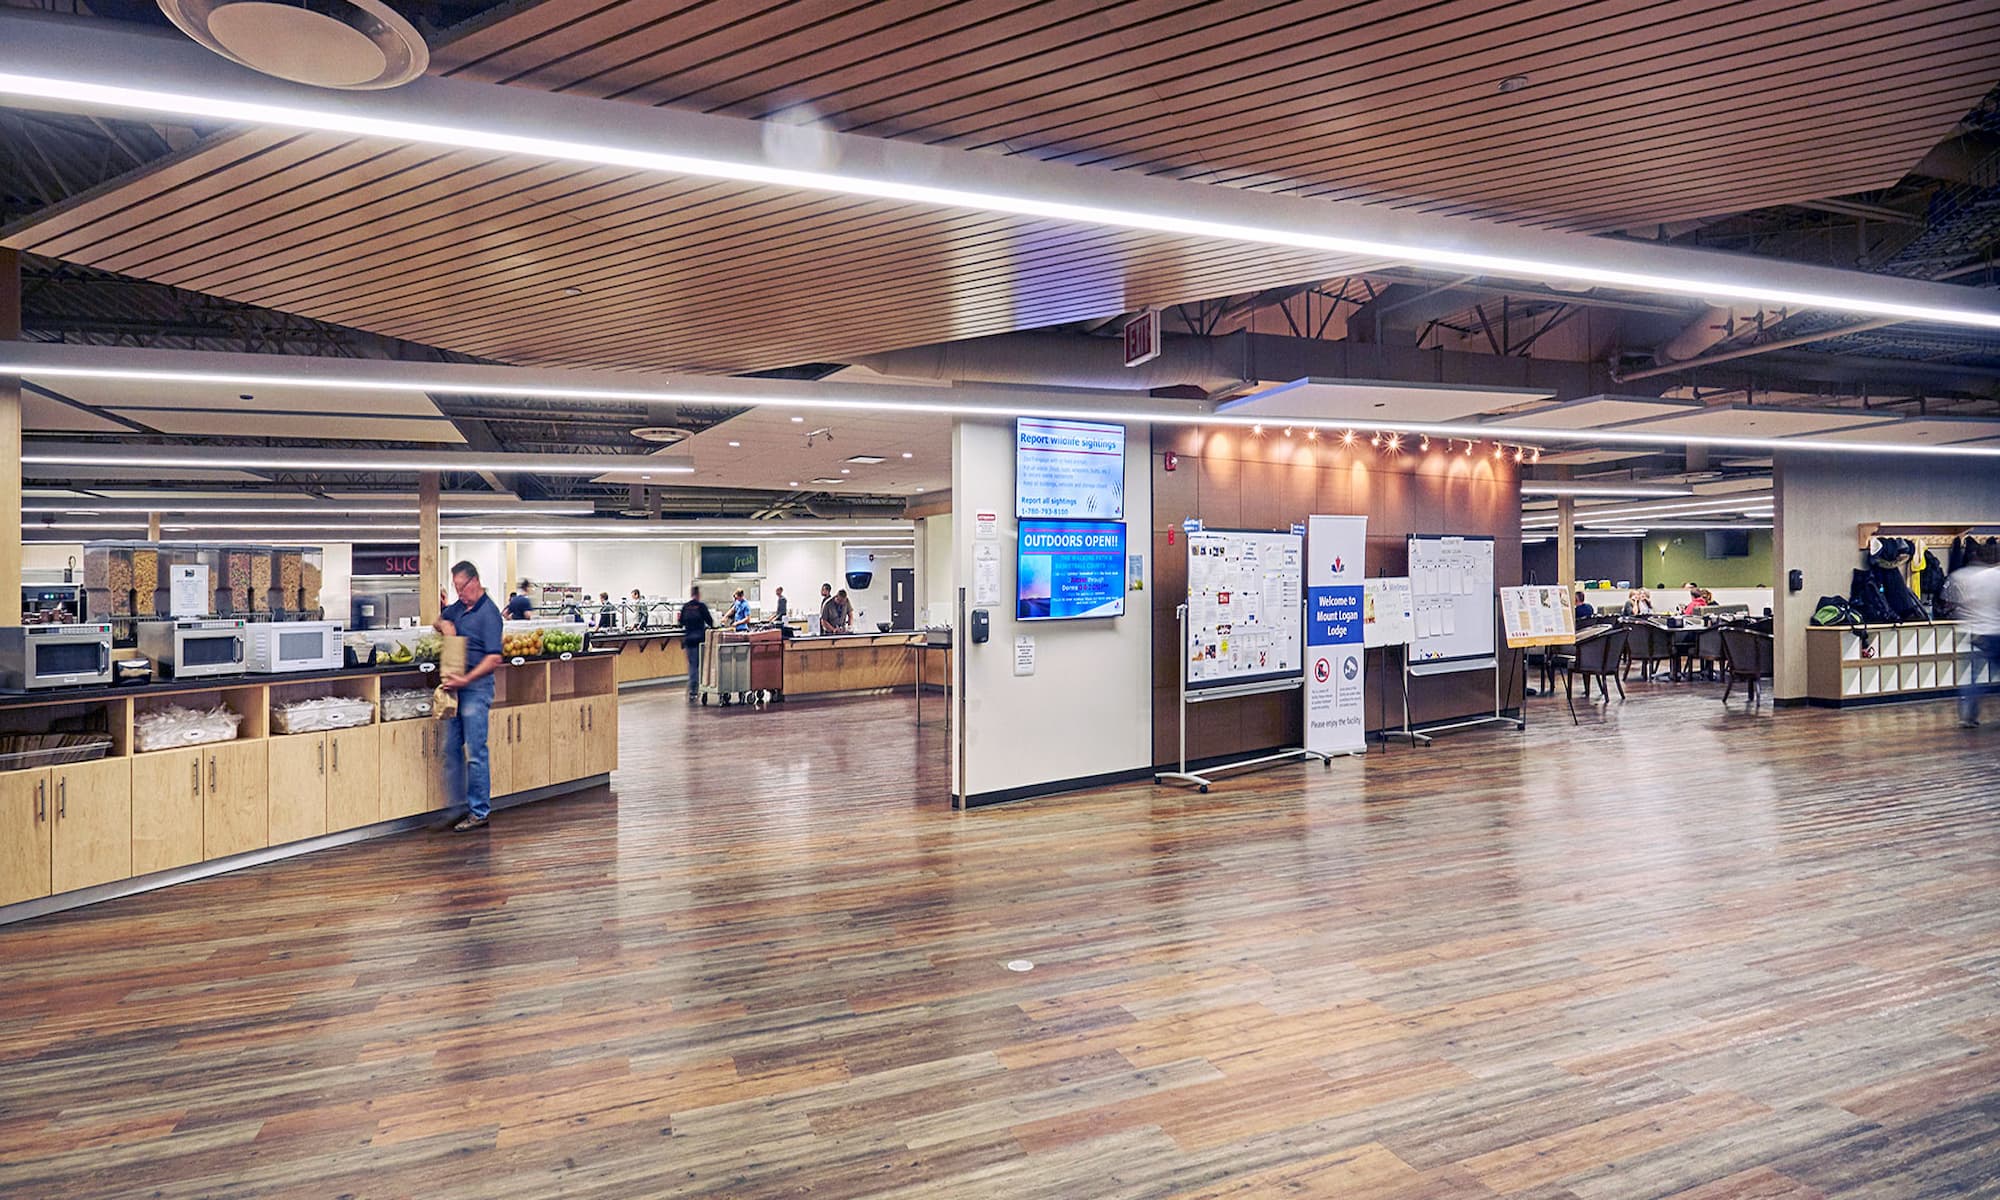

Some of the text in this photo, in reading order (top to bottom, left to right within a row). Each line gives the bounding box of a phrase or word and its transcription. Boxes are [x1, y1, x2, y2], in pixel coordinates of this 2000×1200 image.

[1020, 432, 1117, 450] Report wildlife sightings
[1021, 496, 1041, 505] Report
[1051, 498, 1077, 506] sightings
[1024, 534, 1118, 547] OUTDOORS OPEN!!
[385, 557, 420, 572] SLIC
[1319, 595, 1356, 606] Welcome to
[1316, 610, 1358, 623] Mount Logan
[1327, 624, 1347, 637] Lodge
[1311, 716, 1361, 729] Please enjoy the facility
